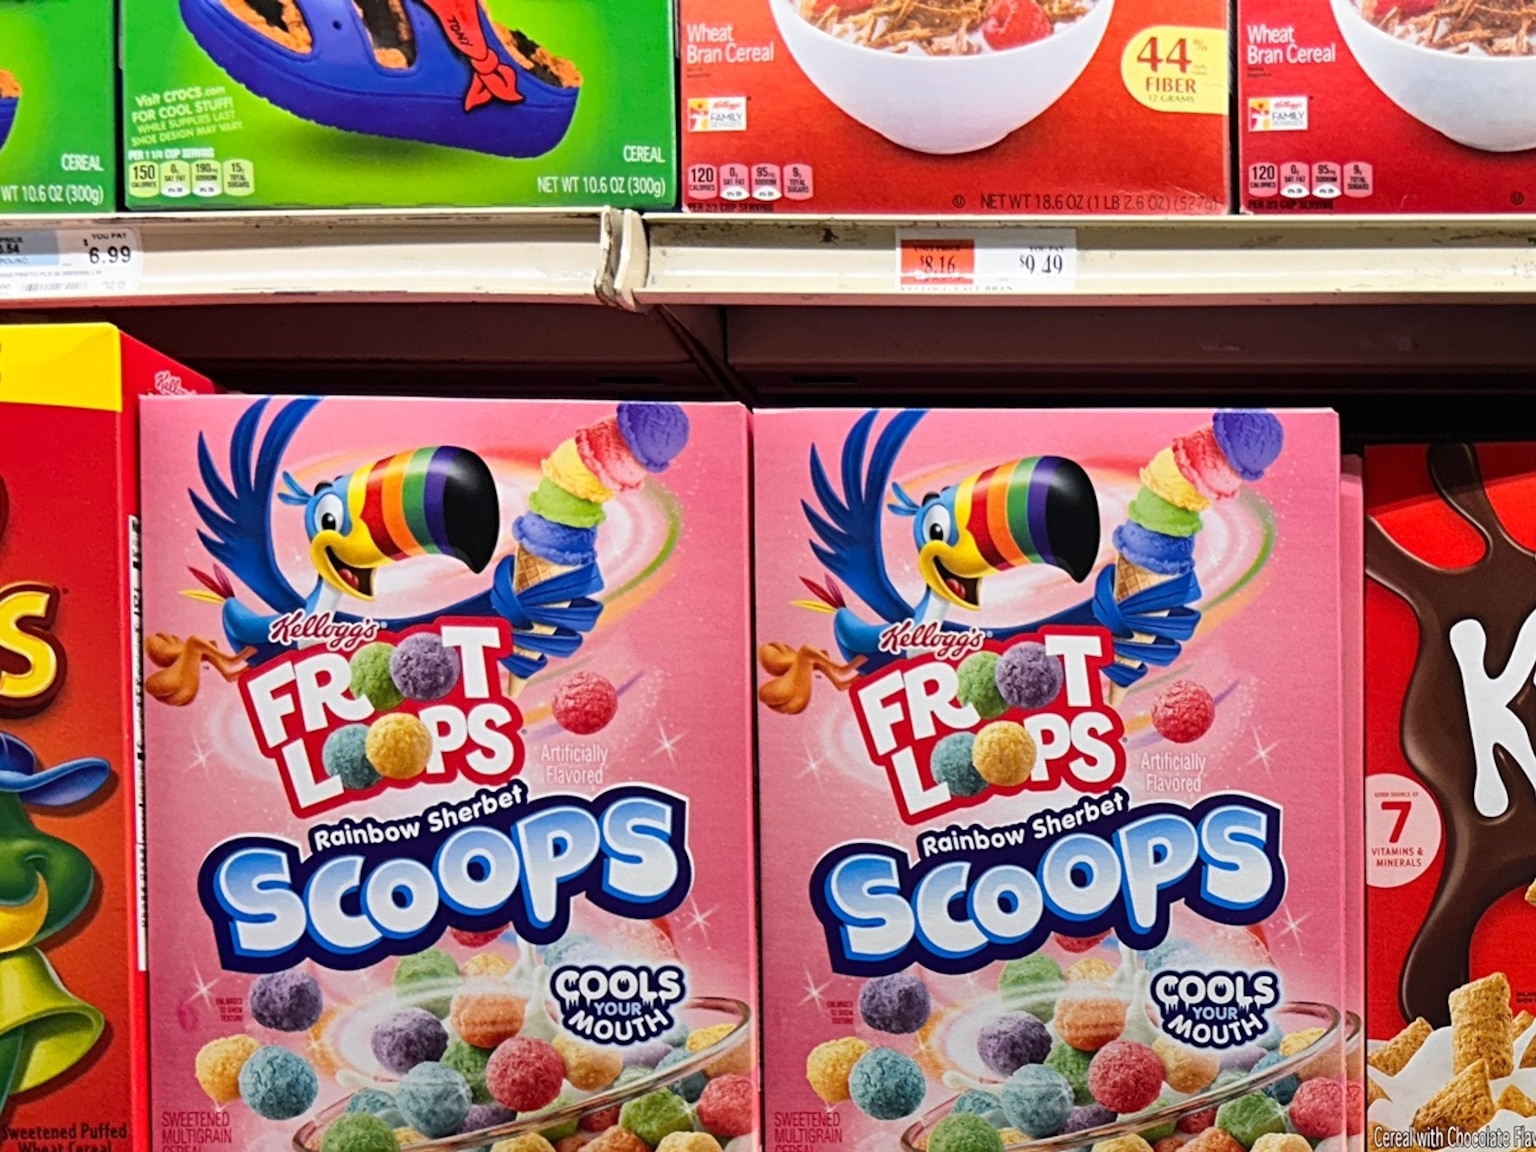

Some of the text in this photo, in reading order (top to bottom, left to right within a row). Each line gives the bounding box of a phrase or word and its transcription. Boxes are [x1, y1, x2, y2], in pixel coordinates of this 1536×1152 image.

[1247, 24, 1295, 44] Wheat
[1247, 43, 1336, 64] Bran Cereal
[1145, 76, 1196, 94] FIBER
[132, 108, 156, 122] FOR
[159, 104, 191, 119] COOL
[623, 146, 665, 163] CEREAL
[131, 164, 156, 181] 150
[538, 176, 666, 196] NET WT 10.6 OZ (300g)
[270, 612, 380, 648] Kellogg's
[879, 622, 985, 659] Kellogg's
[540, 744, 609, 766] Artificially
[545, 765, 603, 786] Flavored
[314, 784, 523, 851] Rainbow Sherbet
[923, 792, 1124, 857] Rainbow Sherbet
[1381, 803, 1413, 842] 7
[552, 968, 682, 1005] COOLS
[594, 999, 642, 1016] YOUR
[568, 1008, 666, 1041] MOUTH
[2, 1123, 127, 1141] Sweetened Puffed
[1374, 1128, 1414, 1148] Cereal
[1417, 1128, 1443, 1148] with
[1447, 1127, 1510, 1149] Chocolate
